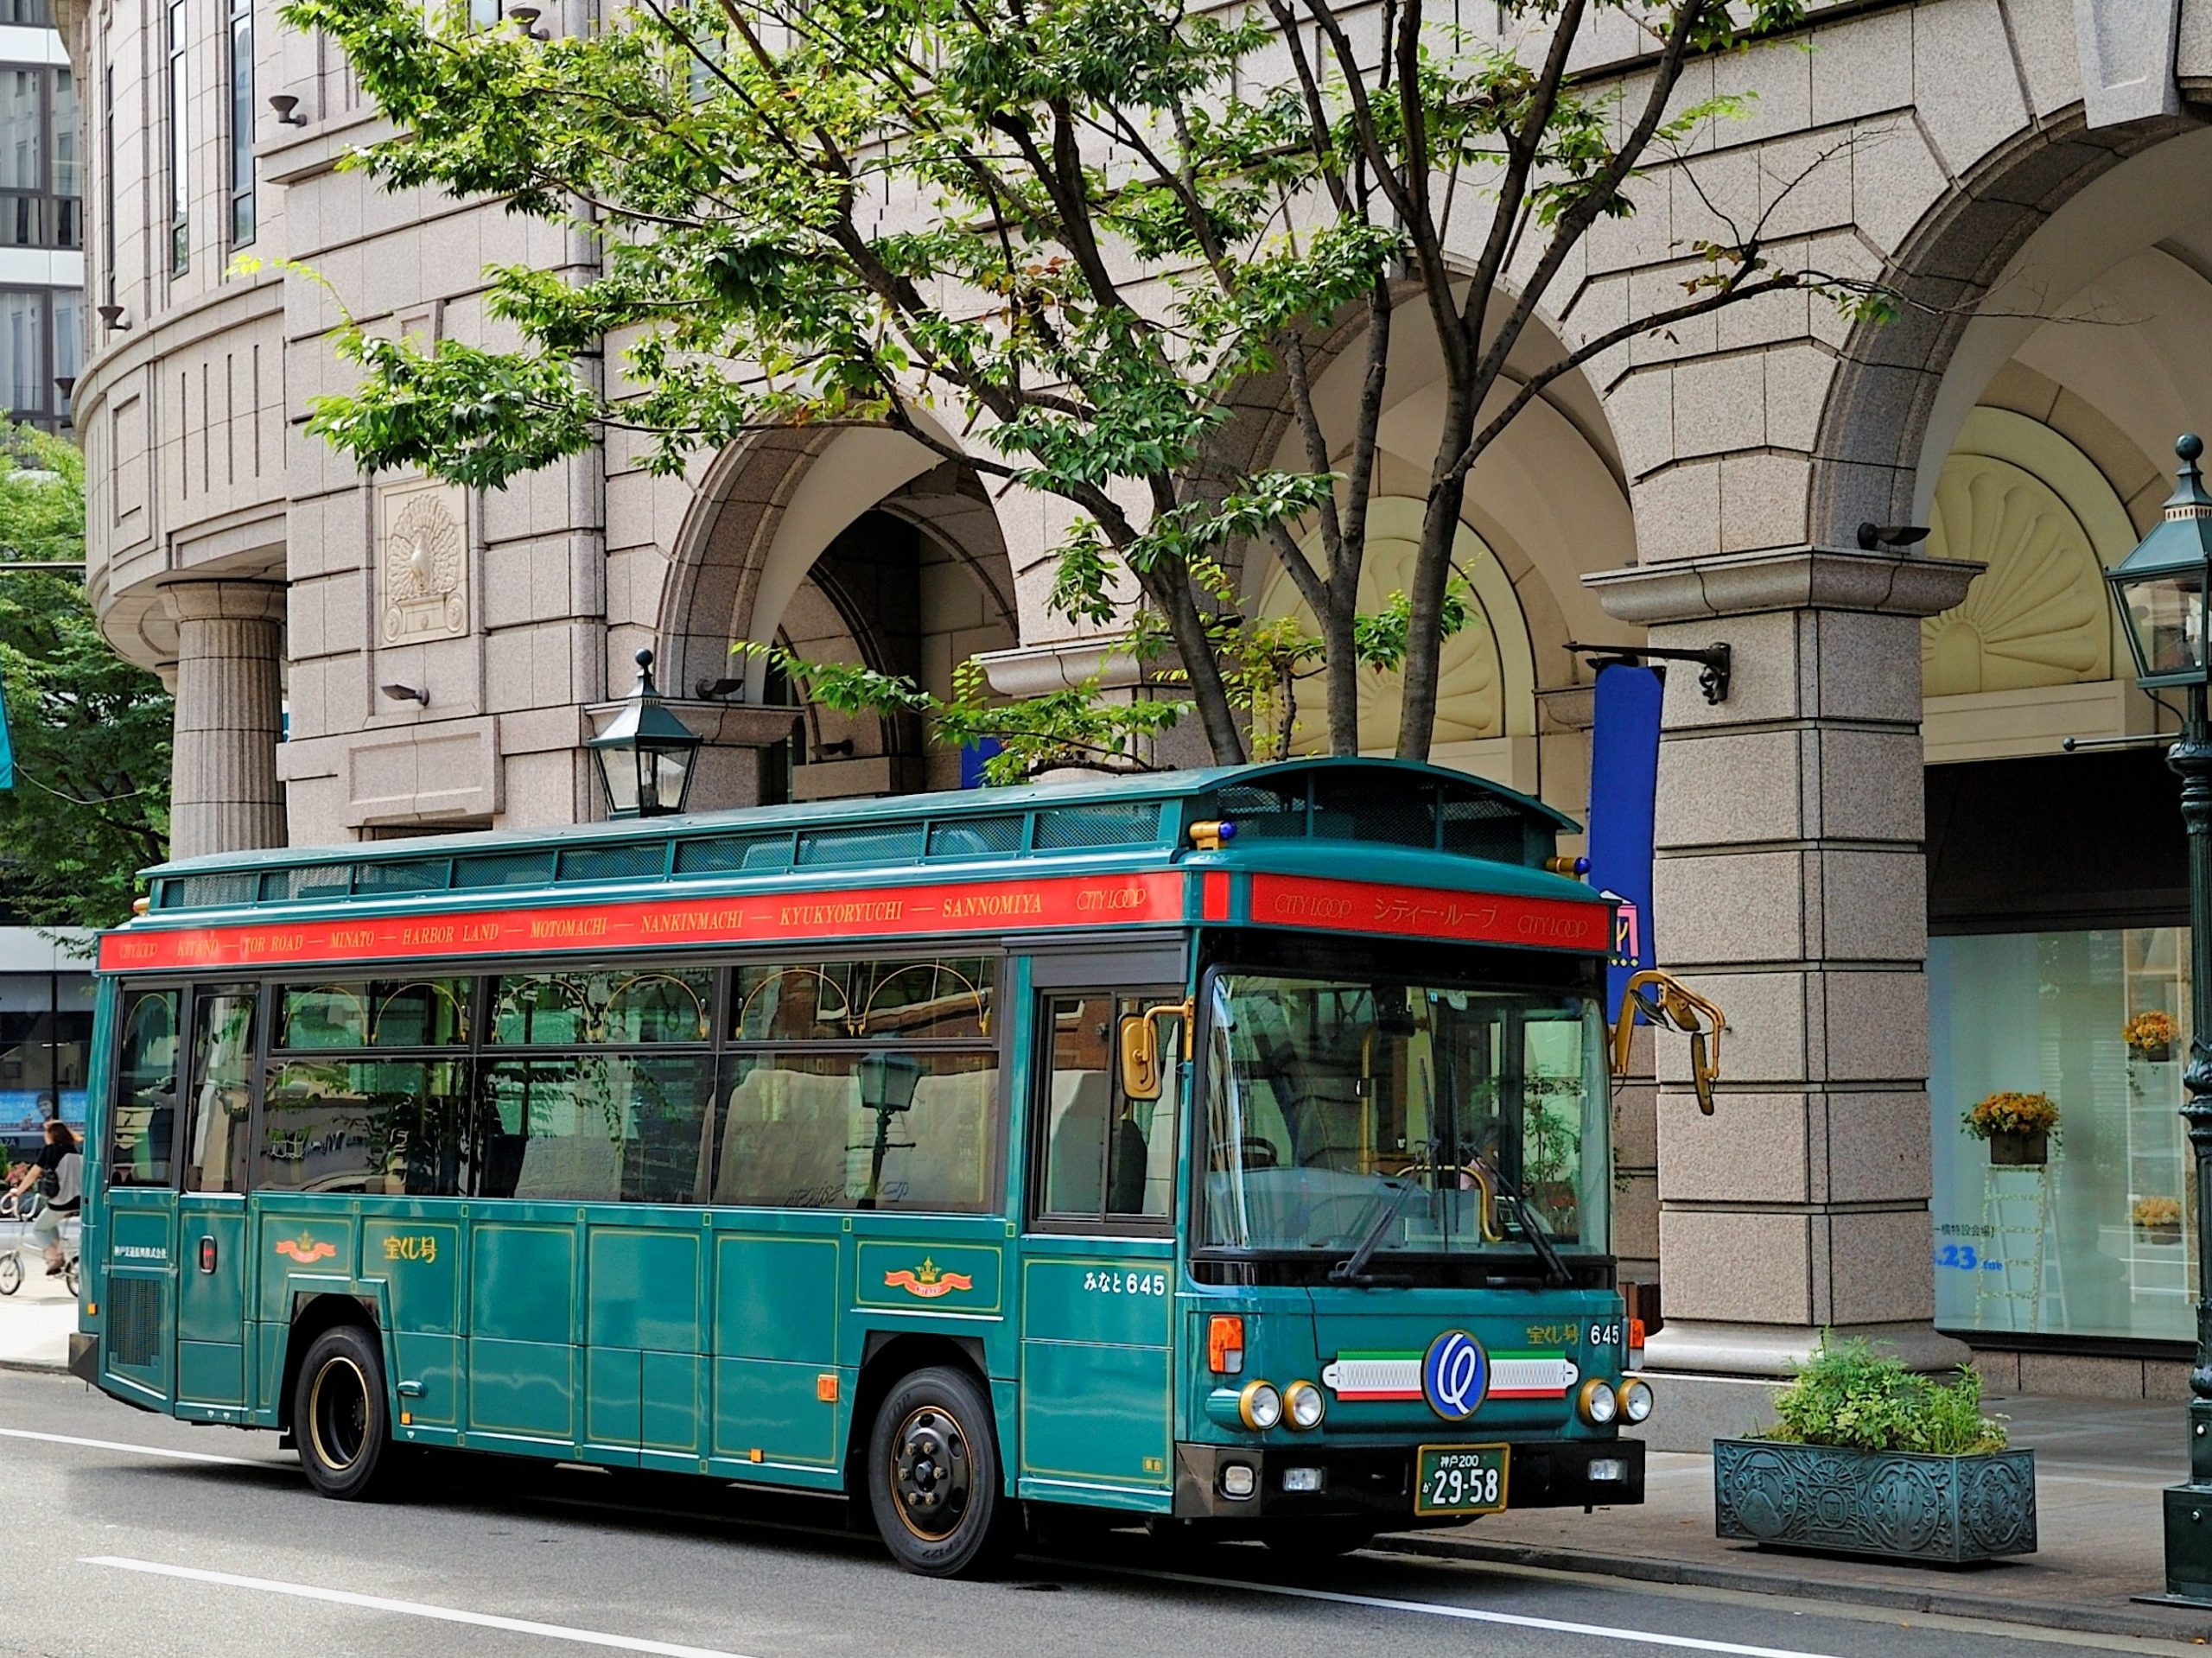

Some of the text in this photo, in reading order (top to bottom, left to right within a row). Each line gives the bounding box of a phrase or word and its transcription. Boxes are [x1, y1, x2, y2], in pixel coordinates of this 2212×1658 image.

[1077, 888, 1147, 911] CITY LOOP
[1274, 893, 1352, 918] CITY LOOP
[177, 893, 1043, 956] KITANO TOR ROAD MINATO HARBOR LAND MOTOMACHI NANKINMACHI KYUKYORYUCHI SANNOMIYA
[1517, 914, 1588, 938] CITY LOOP
[383, 1236, 437, 1263] 宝くじ号
[1084, 1272, 1165, 1296] みなと 645
[1591, 1324, 1619, 1345] 645
[1433, 1469, 1498, 1504] 29-58
